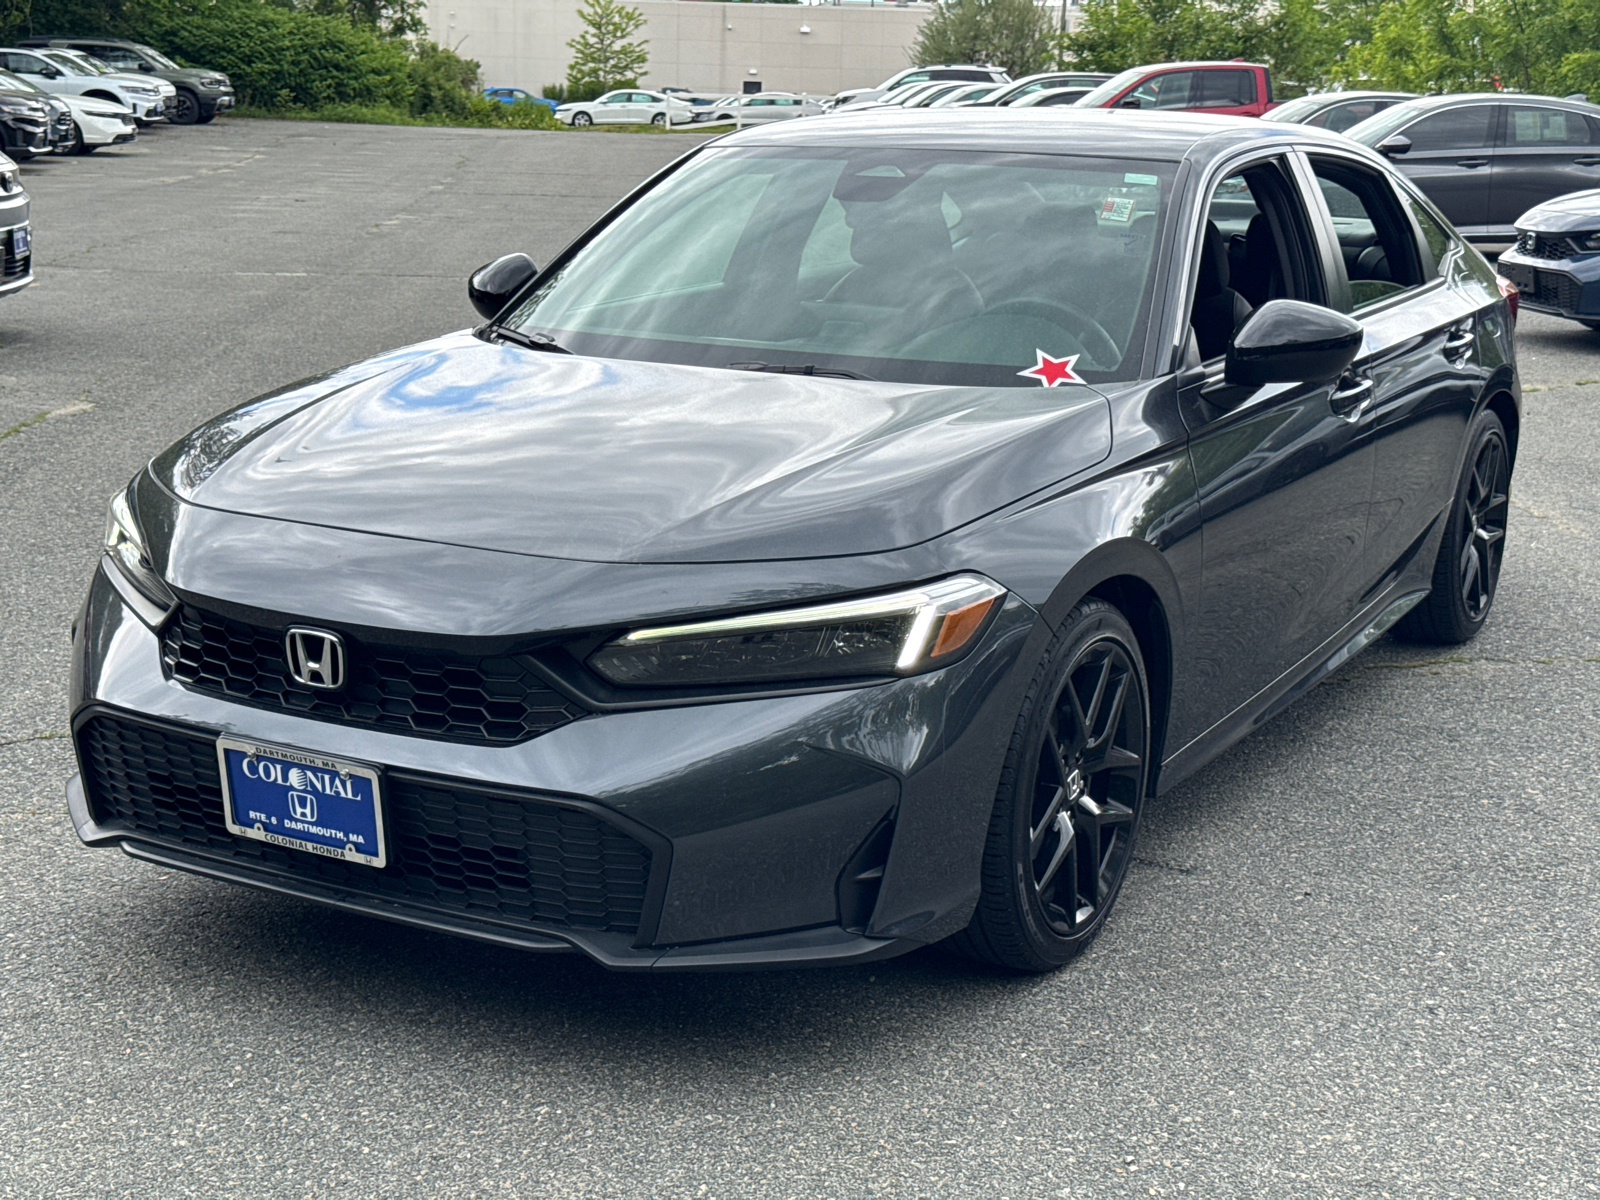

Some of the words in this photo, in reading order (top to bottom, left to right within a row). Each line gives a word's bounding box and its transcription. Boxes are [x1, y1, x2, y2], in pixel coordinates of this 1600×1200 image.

[255, 746, 320, 767] DARTMOUTH,
[321, 760, 338, 770] MA
[242, 757, 362, 801] COLONIAL
[248, 810, 270, 823] RTE.
[270, 816, 278, 825] 6
[284, 819, 347, 842] DARTMOUTH,
[348, 833, 365, 844] MA
[264, 833, 310, 851] COLONIAL
[311, 844, 346, 859] HONDA
